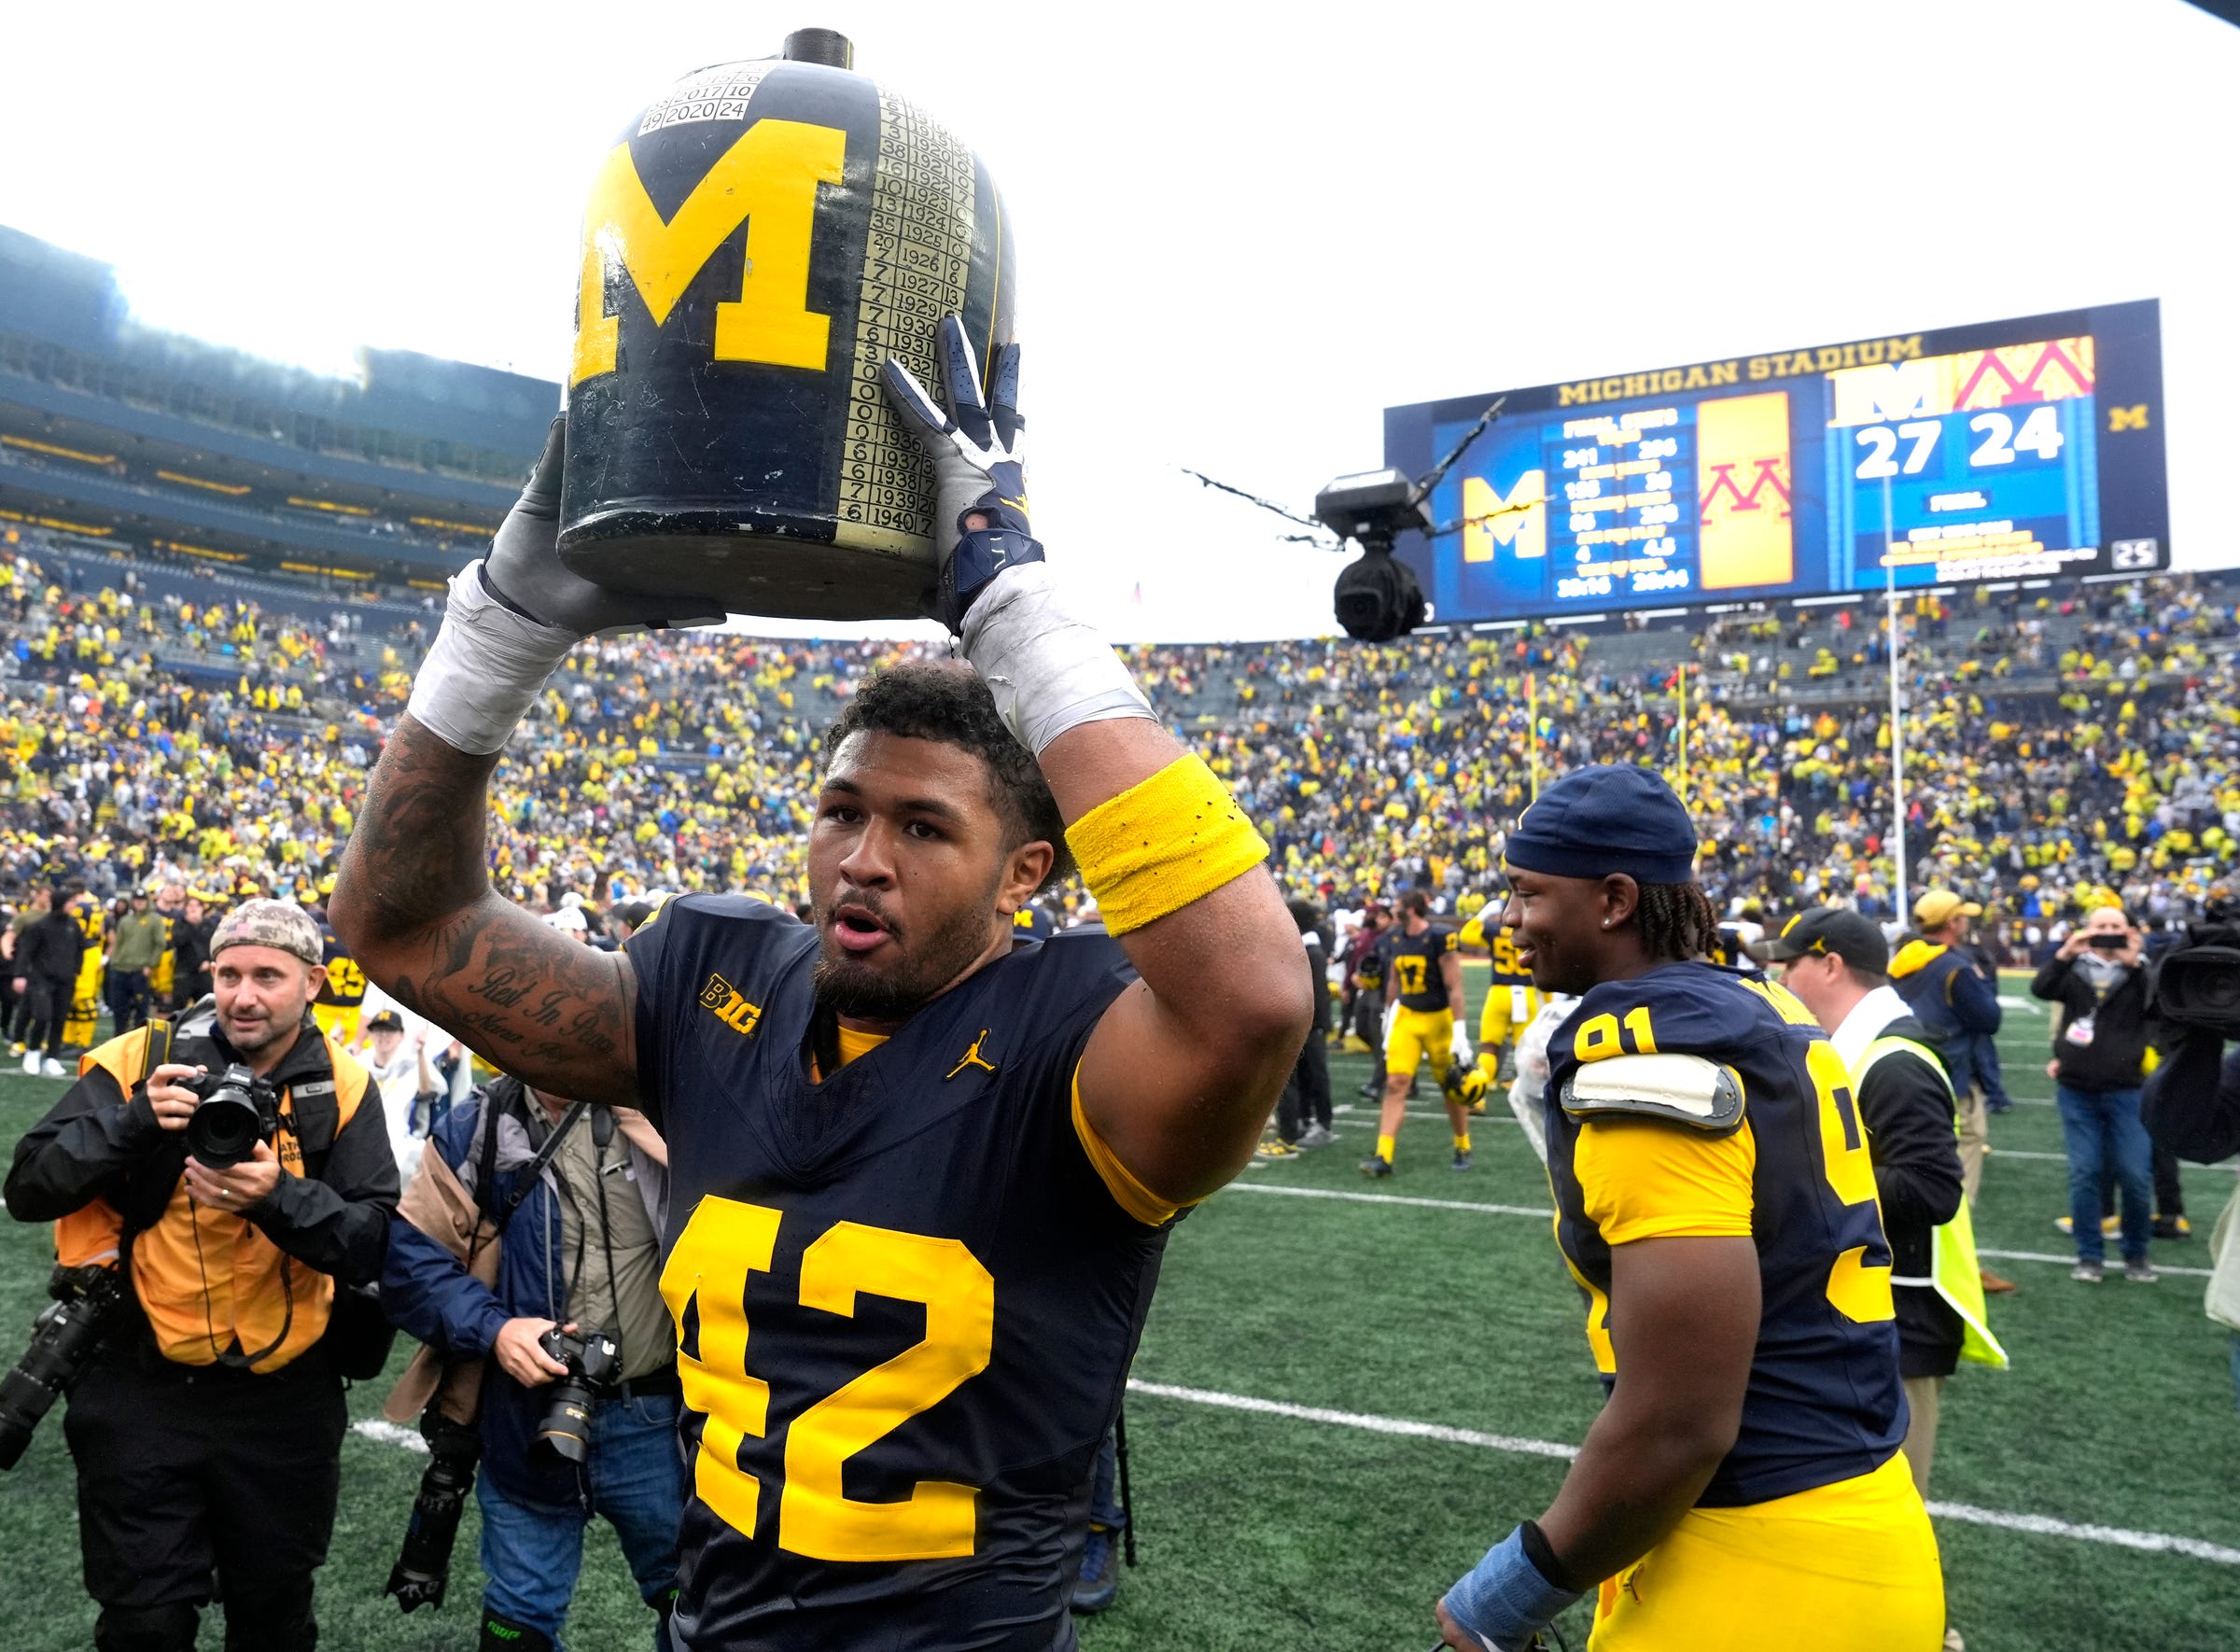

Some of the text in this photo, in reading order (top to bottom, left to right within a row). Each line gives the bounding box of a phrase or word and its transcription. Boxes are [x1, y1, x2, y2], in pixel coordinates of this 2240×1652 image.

[674, 86, 722, 103] 2017
[728, 86, 751, 97] 10
[887, 102, 899, 111] 6
[642, 102, 744, 132] 49 2020 24
[889, 112, 902, 125] 7
[912, 119, 949, 147] 1919
[882, 140, 969, 189] 38 1921 0
[889, 125, 901, 140] 3
[913, 133, 951, 163] 1920
[957, 161, 969, 174] 0
[884, 158, 969, 204] 16 1922 7
[881, 176, 968, 221] 10 1923 0
[877, 194, 967, 239] 13 1924 0
[873, 213, 963, 257] 35 1925 0
[570, 119, 846, 388] M
[874, 234, 960, 273] 20 1926 0
[877, 247, 959, 285] 7 6
[871, 286, 937, 317] 7 1929
[874, 264, 959, 305] 7 1927 13
[869, 306, 936, 338] 7 1930
[865, 345, 878, 360] 3
[866, 327, 931, 357] 6 1931
[863, 364, 876, 380] 0
[1559, 334, 1924, 406] MICHIGAN STADIUM
[860, 385, 875, 400] 0
[857, 404, 873, 420] 0
[2108, 404, 2149, 431] M
[856, 425, 921, 452] 0 1936
[1855, 406, 2064, 480] 27 24
[853, 443, 867, 461] 6
[880, 448, 920, 472] 1937
[851, 464, 935, 495] 6 1938 7
[850, 483, 936, 516] 7 1939 20
[1463, 469, 1546, 563] M
[847, 504, 932, 535] 6 1940 7
[2114, 541, 2152, 567] 25
[1394, 955, 1428, 995] 17
[468, 966, 538, 1010] Rest
[523, 990, 571, 1026] In
[658, 1194, 995, 1562] 42
